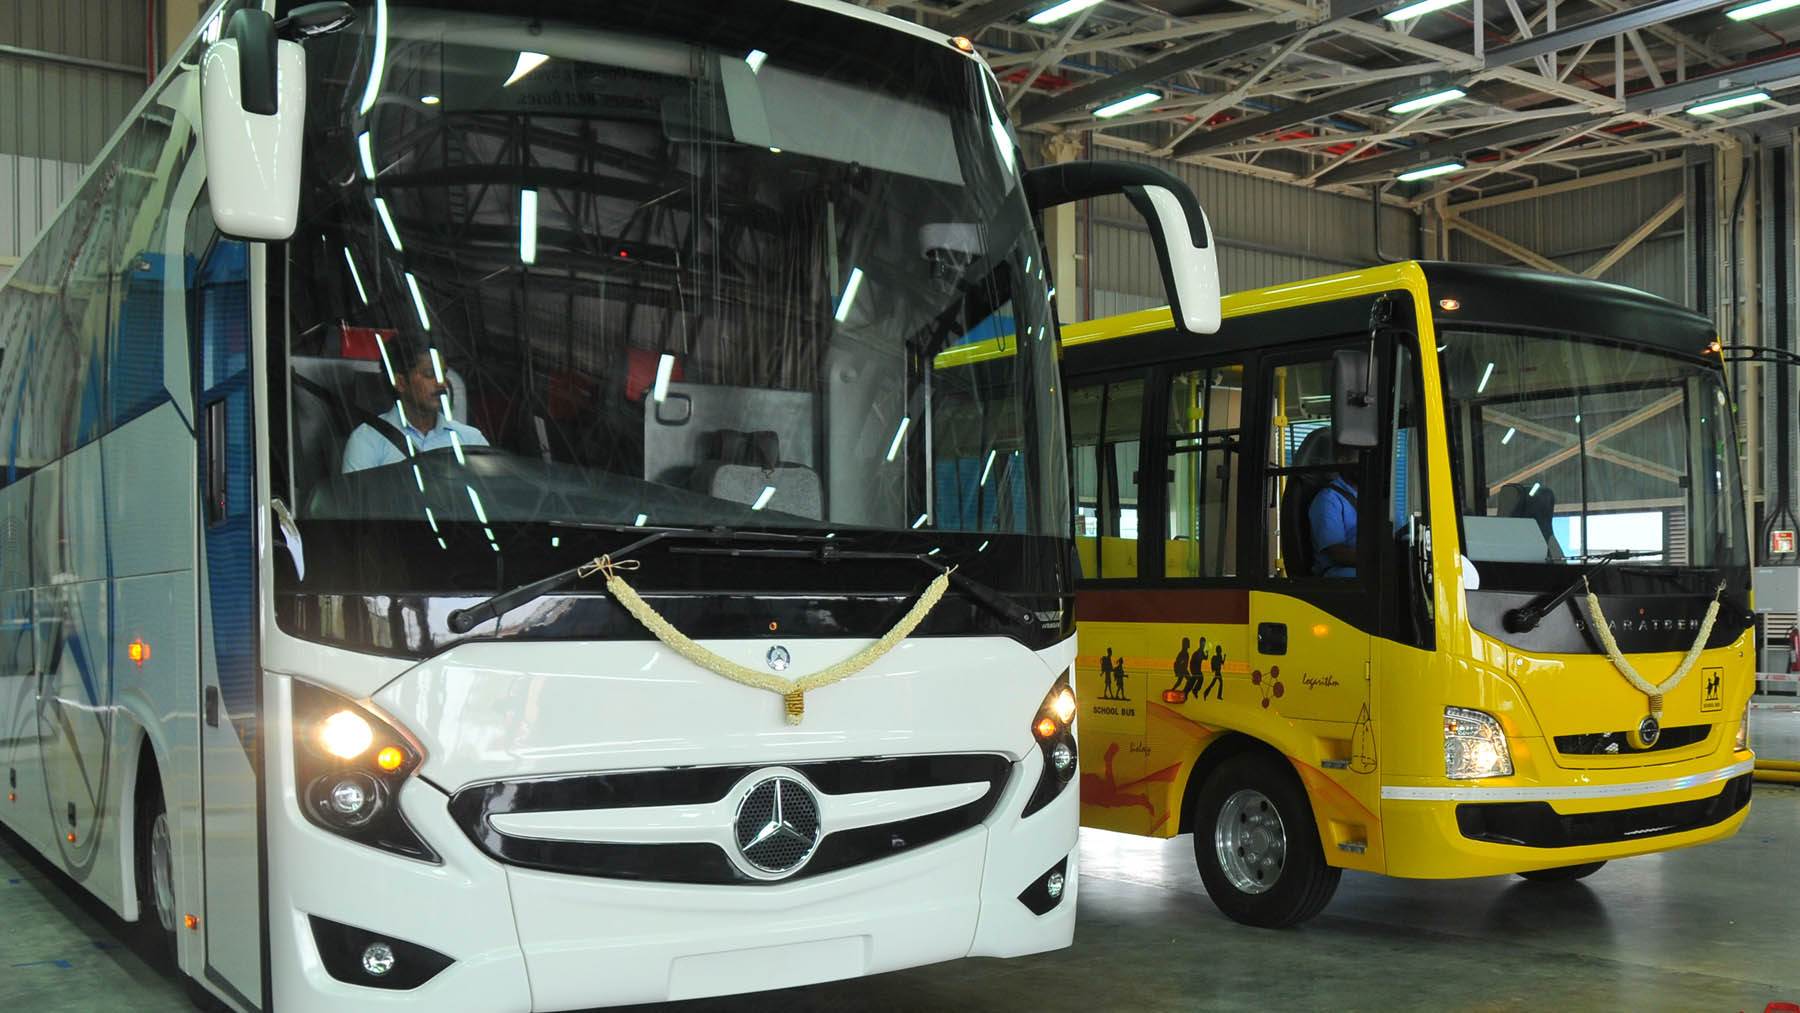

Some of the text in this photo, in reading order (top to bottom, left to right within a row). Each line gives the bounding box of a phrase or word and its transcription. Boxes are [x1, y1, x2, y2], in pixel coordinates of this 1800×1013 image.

[1575, 619, 1706, 631] BARATBEN
[1093, 706, 1136, 717] SCHOOL BUS
